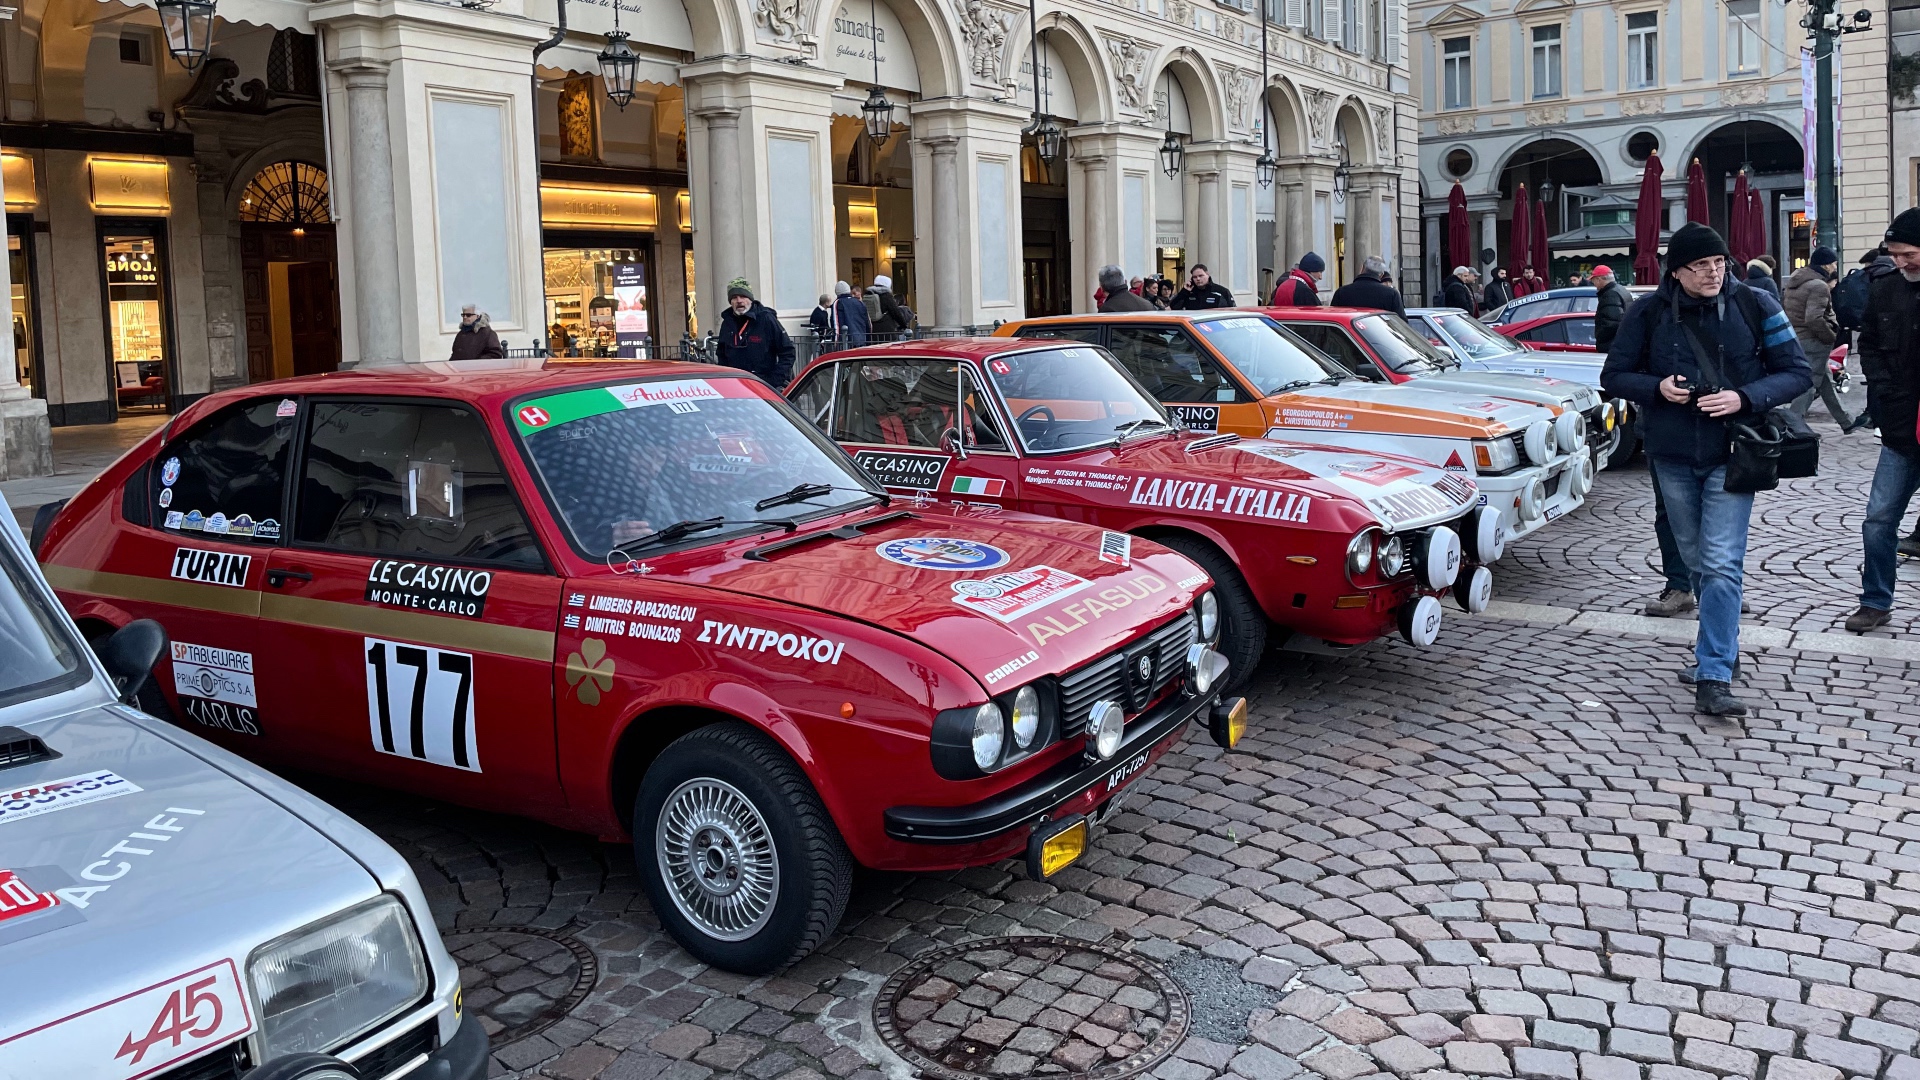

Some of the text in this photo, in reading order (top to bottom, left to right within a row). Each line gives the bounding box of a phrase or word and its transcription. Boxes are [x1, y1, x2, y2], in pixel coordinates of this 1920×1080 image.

[835, 18, 885, 43] sinatra
[993, 361, 1010, 374] H
[623, 385, 718, 402] Autodelta
[522, 408, 548, 425] H
[672, 402, 693, 412] 177
[1176, 407, 1215, 420] SINO
[874, 457, 941, 475] CASINO
[1028, 467, 1049, 475] Driver:
[1054, 469, 1078, 478] RITSON
[1088, 472, 1116, 481] THOMAS
[1025, 475, 1056, 485] Navigator:
[1056, 478, 1075, 486] ROSS
[1084, 480, 1112, 490] THOMAS
[1129, 476, 1311, 523] LANCIA-ITALIA
[257, 525, 280, 533] ACROPOLIS
[176, 548, 250, 586] TURIN
[369, 560, 491, 597] LE CASINO
[991, 575, 1026, 590] 177
[589, 594, 697, 622] LIMBERIS PAPAZOGLOU
[1026, 574, 1167, 647] ALFASUD
[585, 616, 681, 643] DIMITRIS BOUNAZOS
[984, 650, 1040, 685] CARELLO
[368, 642, 472, 768] 177
[54, 807, 206, 909] ACTIFI
